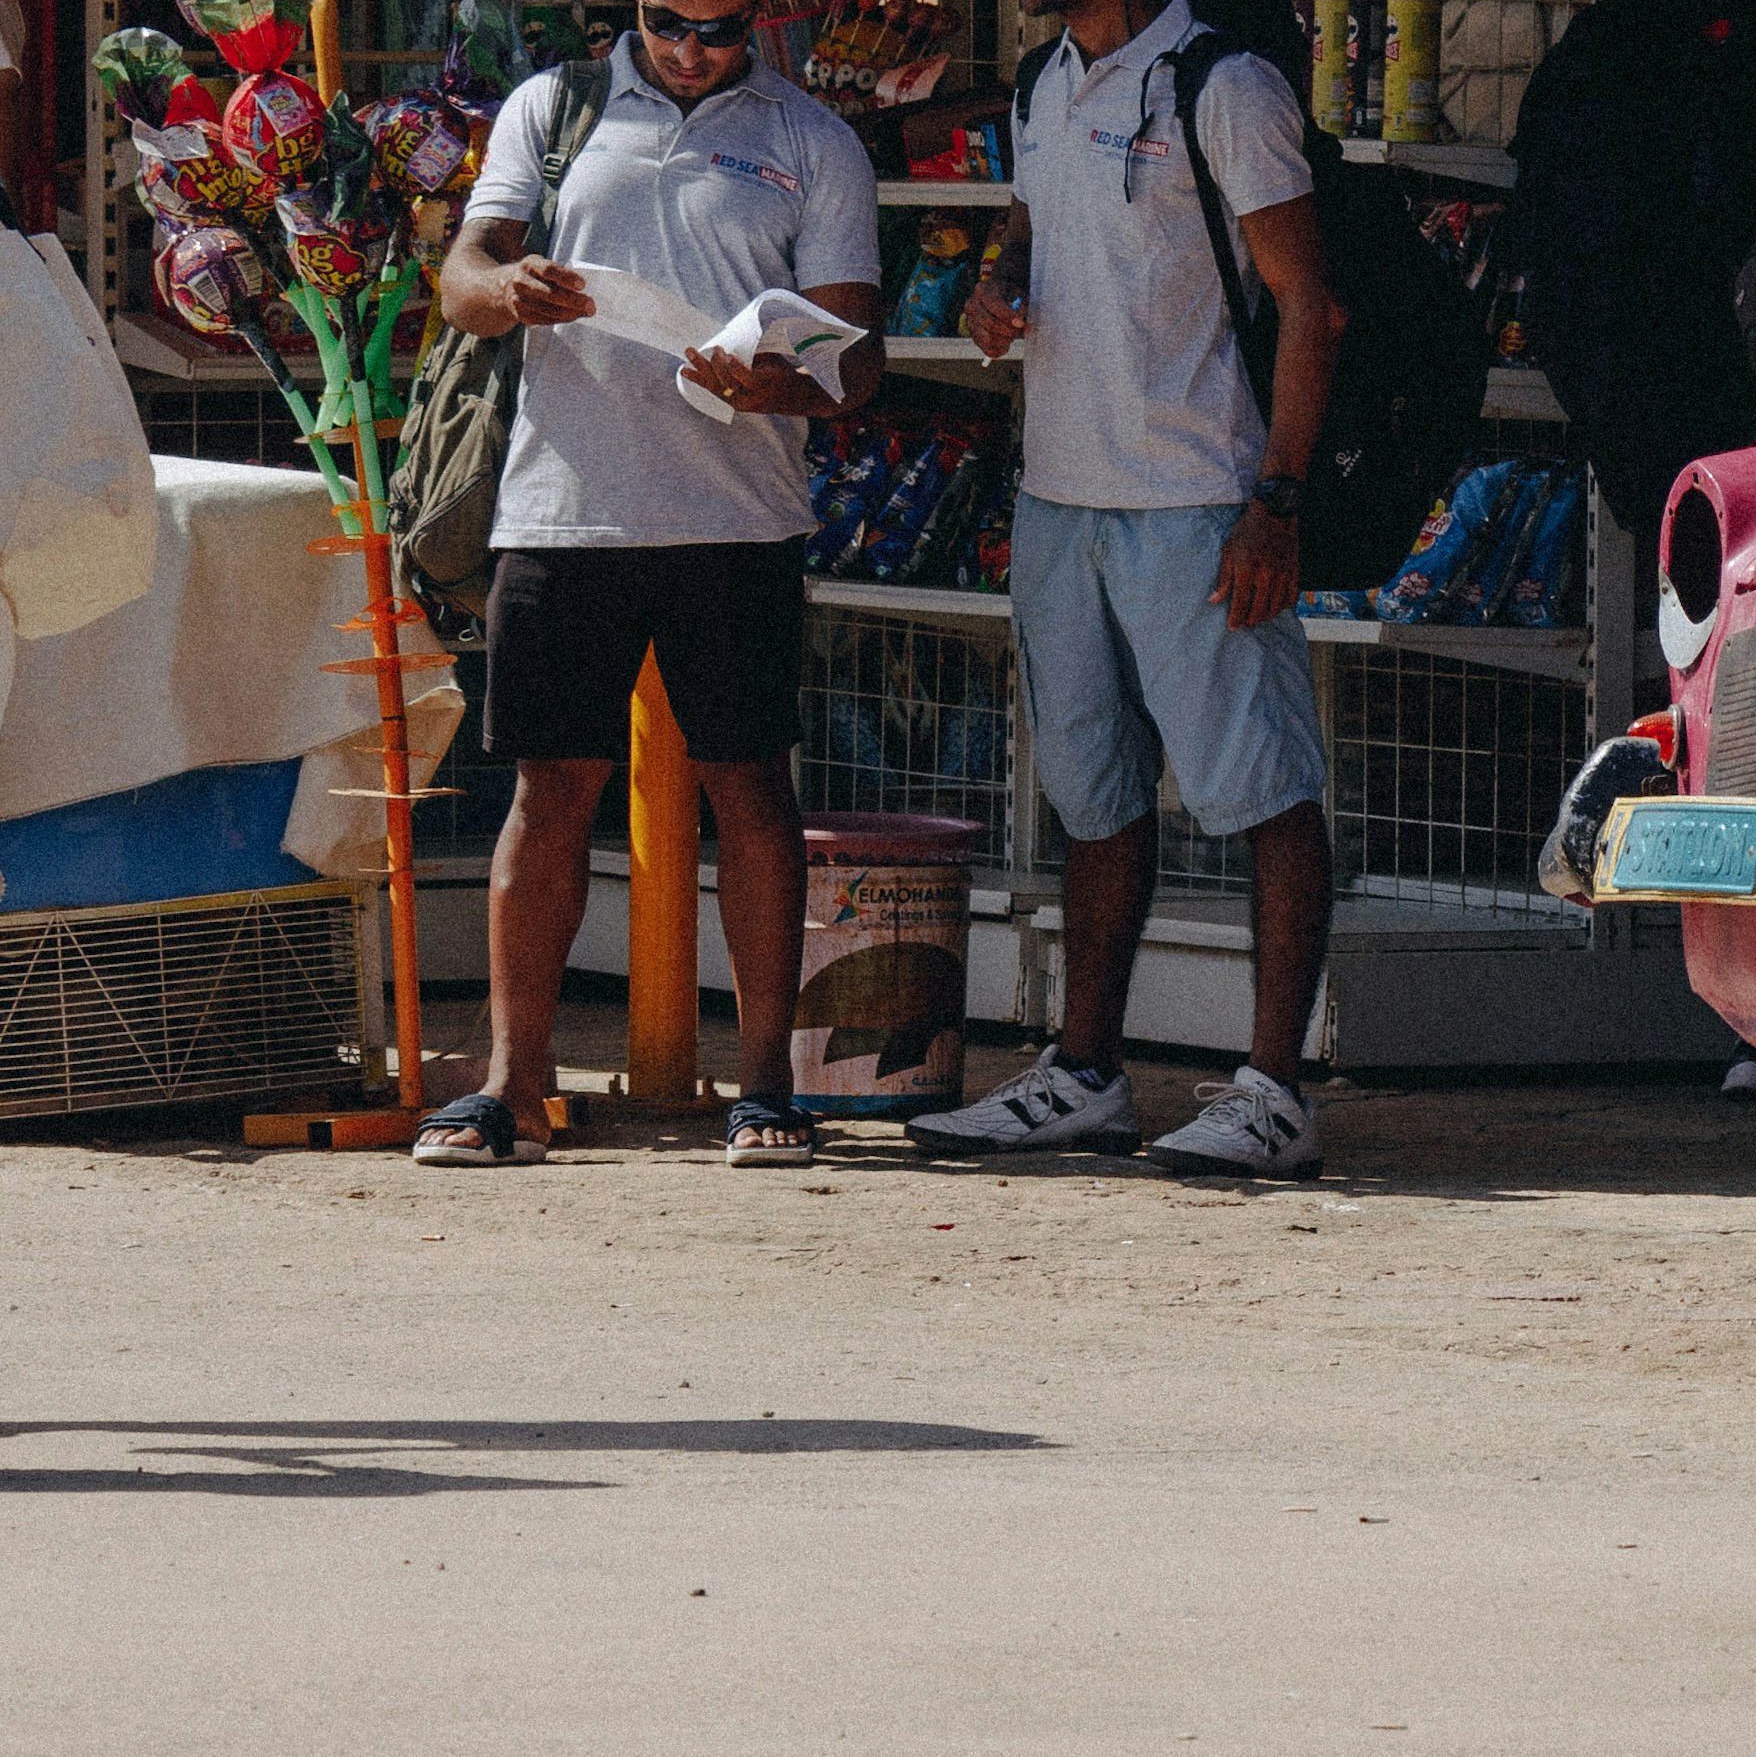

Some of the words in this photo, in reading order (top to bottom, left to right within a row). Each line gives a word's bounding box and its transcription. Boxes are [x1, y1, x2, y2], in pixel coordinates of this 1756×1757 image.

[1090, 129, 1111, 145] RED
[711, 152, 736, 169] RED
[737, 158, 759, 176] SEA
[1629, 820, 1749, 877] STATION
